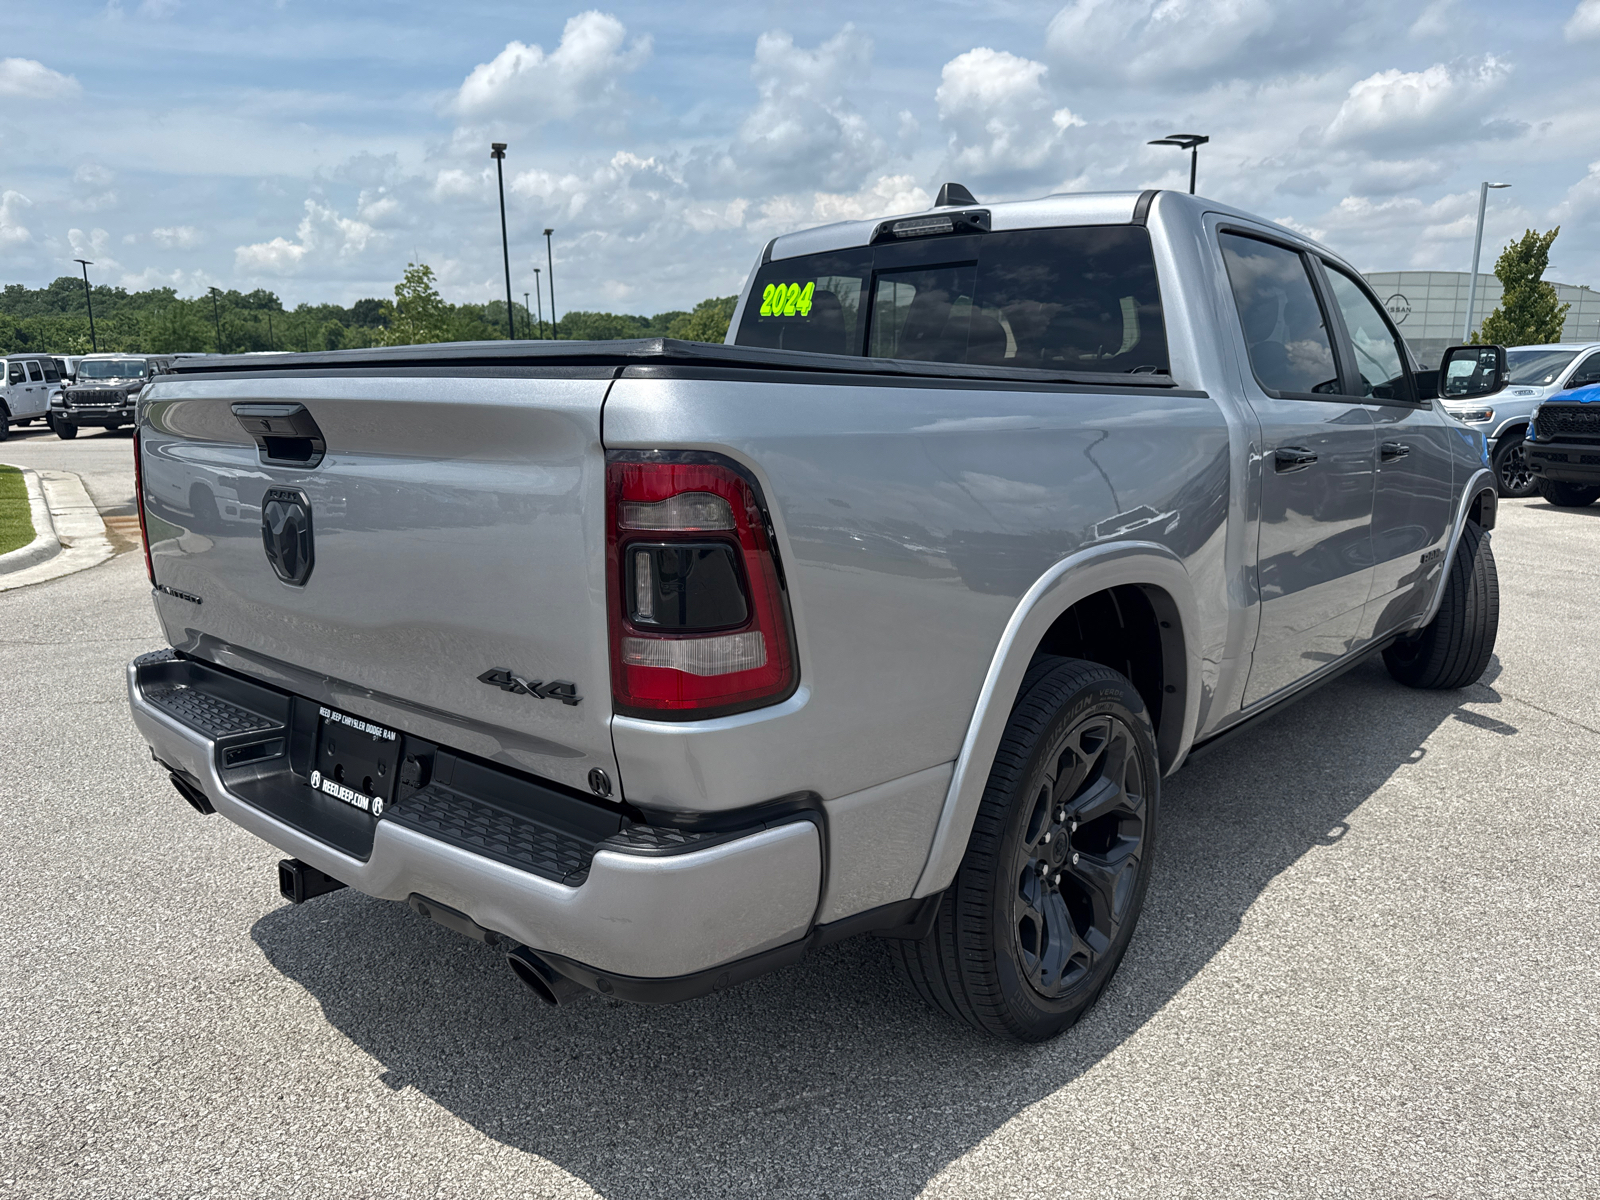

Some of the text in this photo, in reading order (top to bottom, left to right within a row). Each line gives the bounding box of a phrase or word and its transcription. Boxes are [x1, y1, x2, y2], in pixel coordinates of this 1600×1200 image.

[759, 281, 816, 317] 2024
[269, 489, 298, 501] RAM
[1420, 548, 1441, 564] RAM
[1099, 688, 1125, 698] VERDE
[319, 706, 397, 741] REED JEEP CHRYSLER DODGE RAM
[322, 779, 370, 810] REEDJEEP.COM
